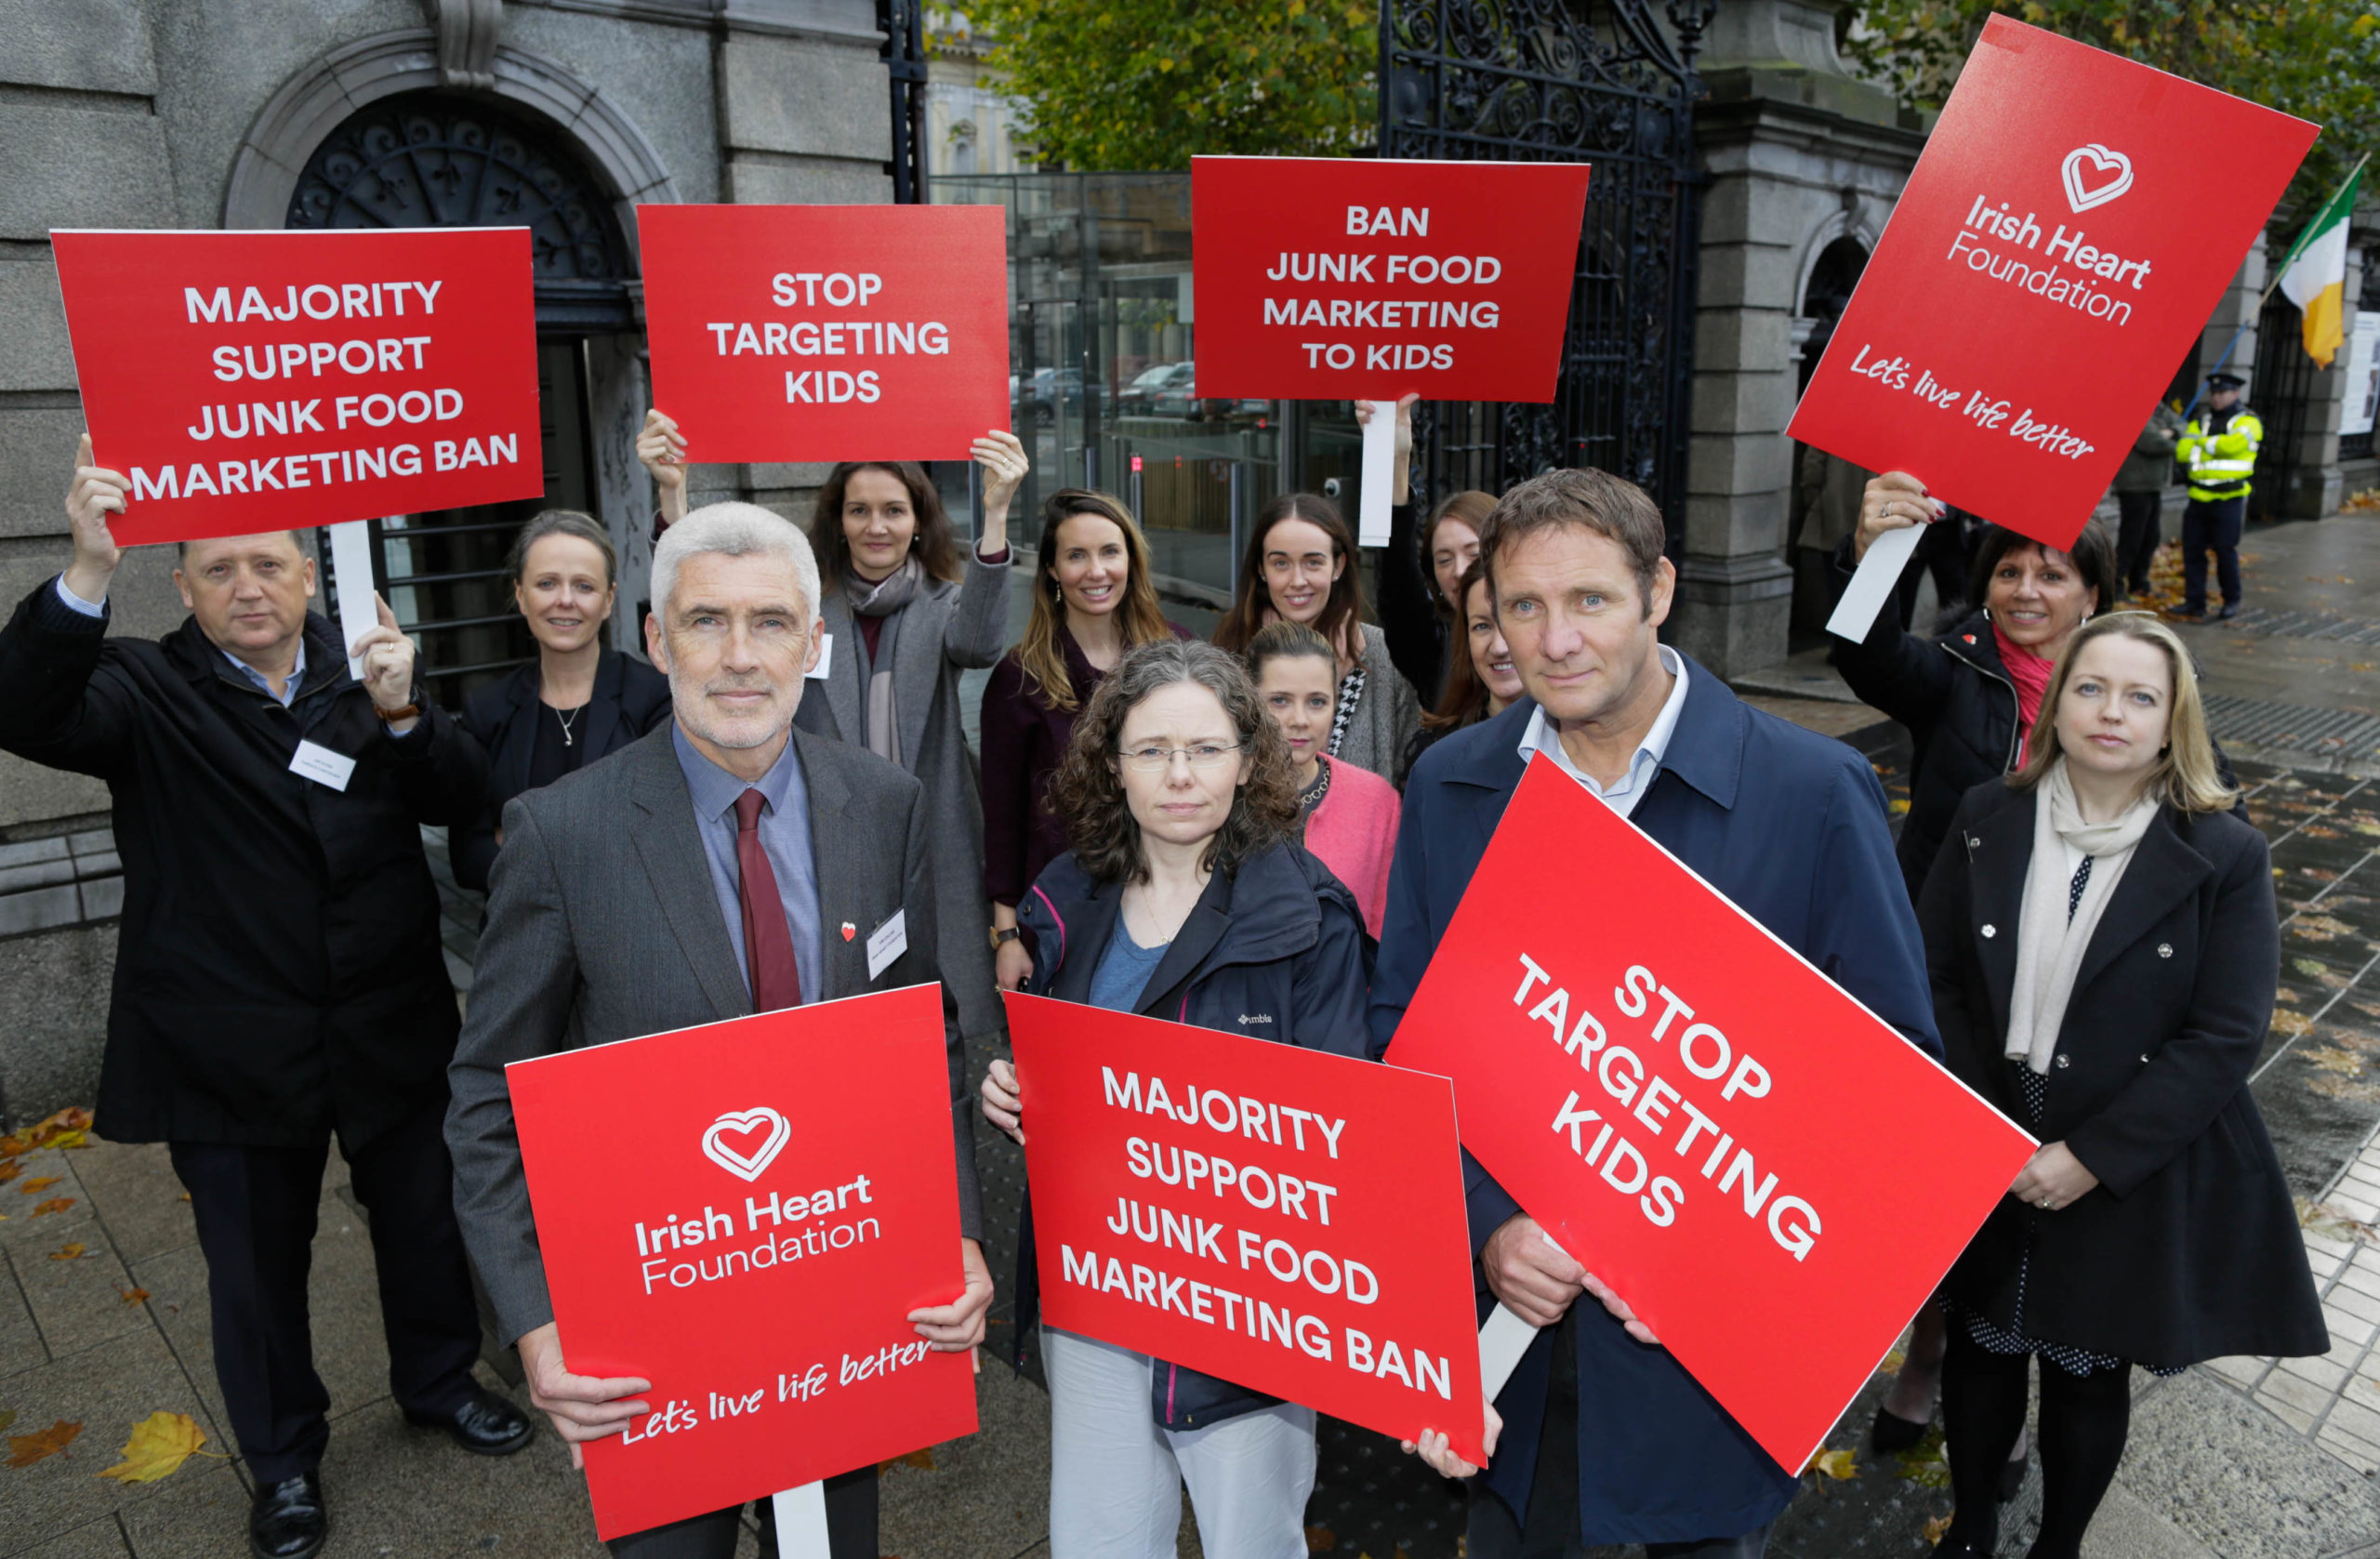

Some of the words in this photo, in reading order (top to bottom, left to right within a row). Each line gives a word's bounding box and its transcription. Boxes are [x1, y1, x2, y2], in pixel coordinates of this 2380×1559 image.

[1347, 206, 1429, 236] BAN
[1964, 194, 2043, 249] Irish
[2045, 224, 2152, 290] Heart
[184, 281, 442, 324] MAJORITY
[773, 271, 882, 308] STOP
[1267, 253, 1376, 283] JUNK
[1387, 256, 1501, 284] FOOD
[1947, 230, 2132, 326] Foundation
[707, 321, 949, 356] TARGETING
[1264, 298, 1499, 328] MARKETING
[213, 337, 431, 382] SUPPORT
[786, 370, 880, 404] KIDS
[1302, 343, 1355, 369] TO
[1367, 344, 1453, 370] KIDS
[188, 399, 324, 442] JUNK
[336, 389, 464, 430] FOOD
[1850, 344, 1910, 390] Let's
[1913, 369, 1961, 408] live
[1963, 390, 2011, 429] life
[2010, 408, 2095, 460] better
[129, 444, 423, 502] MARKETING
[434, 433, 518, 472] BAN
[1615, 965, 1771, 1103] STOP
[1102, 1066, 1345, 1159] MAJORITY
[1514, 953, 1822, 1262] TARGETING
[1127, 1137, 1337, 1226] SUPPORT
[1552, 1090, 1685, 1227] KIDS
[635, 1206, 734, 1257] Irish
[746, 1174, 873, 1232] Heart
[1107, 1197, 1227, 1264] JUNK
[1237, 1229, 1379, 1305] FOOD
[642, 1218, 880, 1294] Foundation
[1062, 1244, 1331, 1361] MARKETING
[1346, 1328, 1451, 1401] BAN
[622, 1400, 698, 1446] Let's
[709, 1389, 764, 1421] live
[778, 1364, 827, 1403] life
[839, 1341, 932, 1387] better
